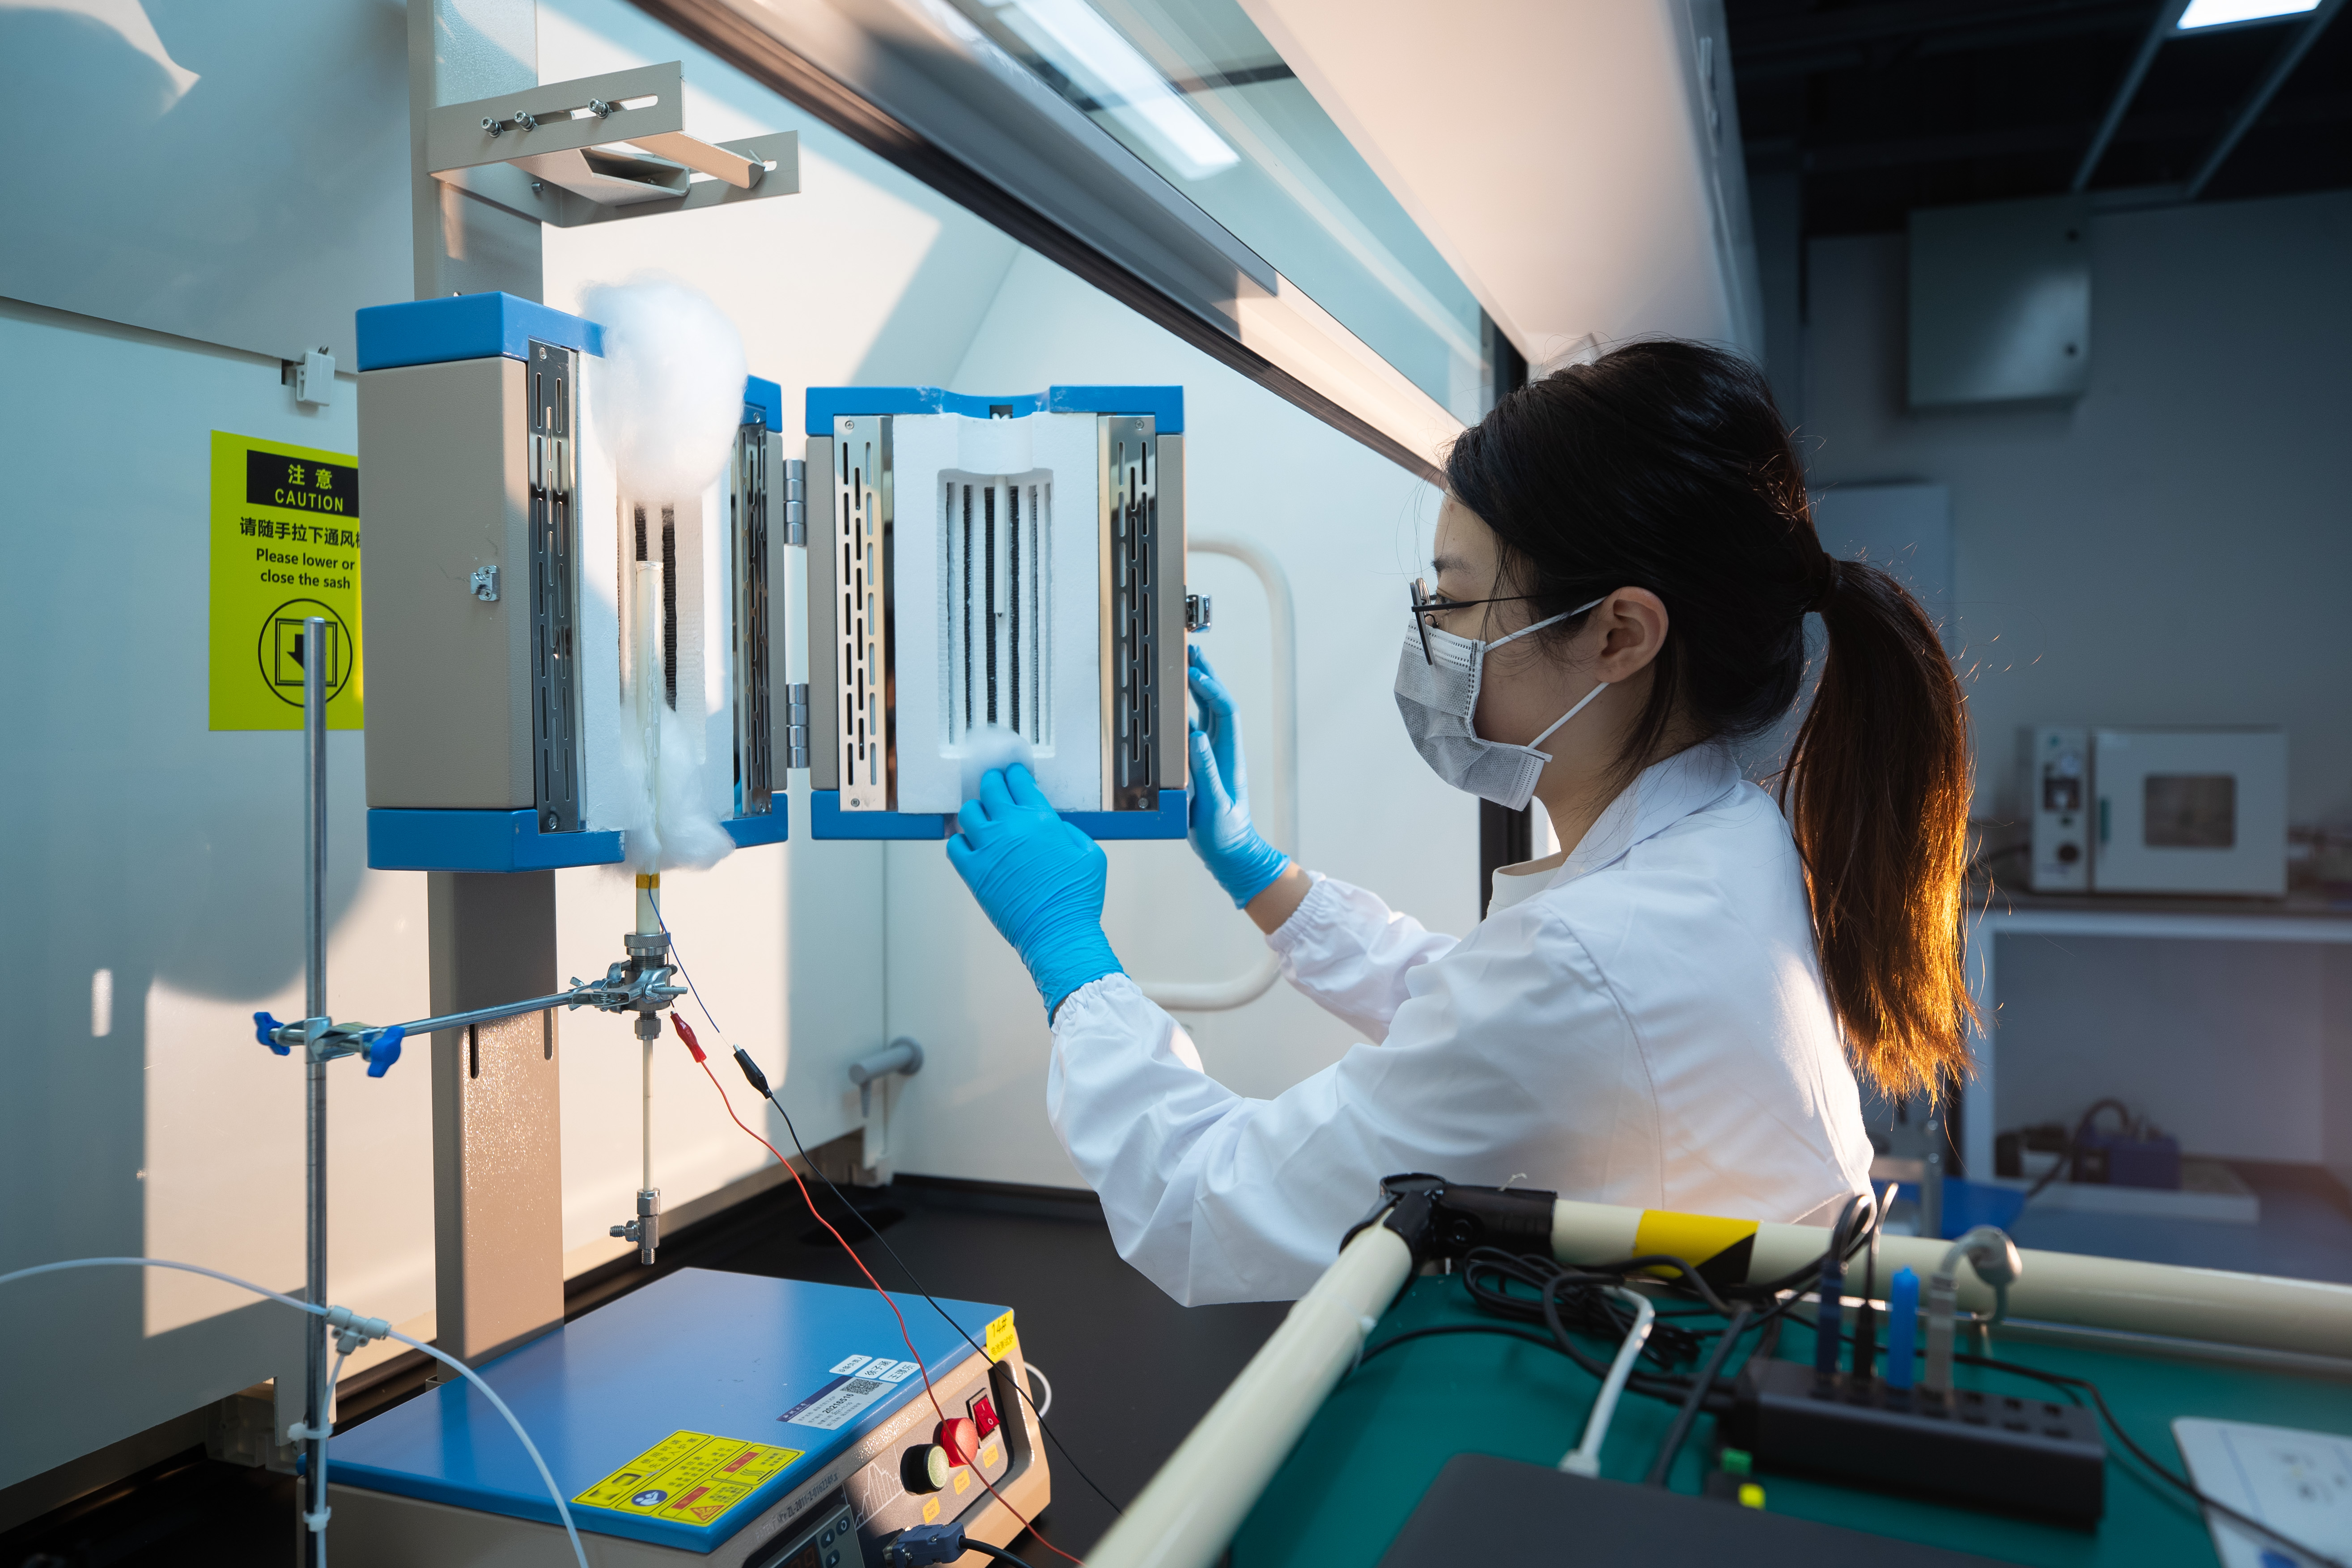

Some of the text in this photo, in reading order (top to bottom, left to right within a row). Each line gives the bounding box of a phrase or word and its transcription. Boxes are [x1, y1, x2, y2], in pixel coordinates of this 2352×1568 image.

[288, 464, 333, 490] 注意
[275, 488, 344, 512] CAUTION
[256, 548, 355, 571] Please lower or
[260, 569, 350, 590] close the sash
